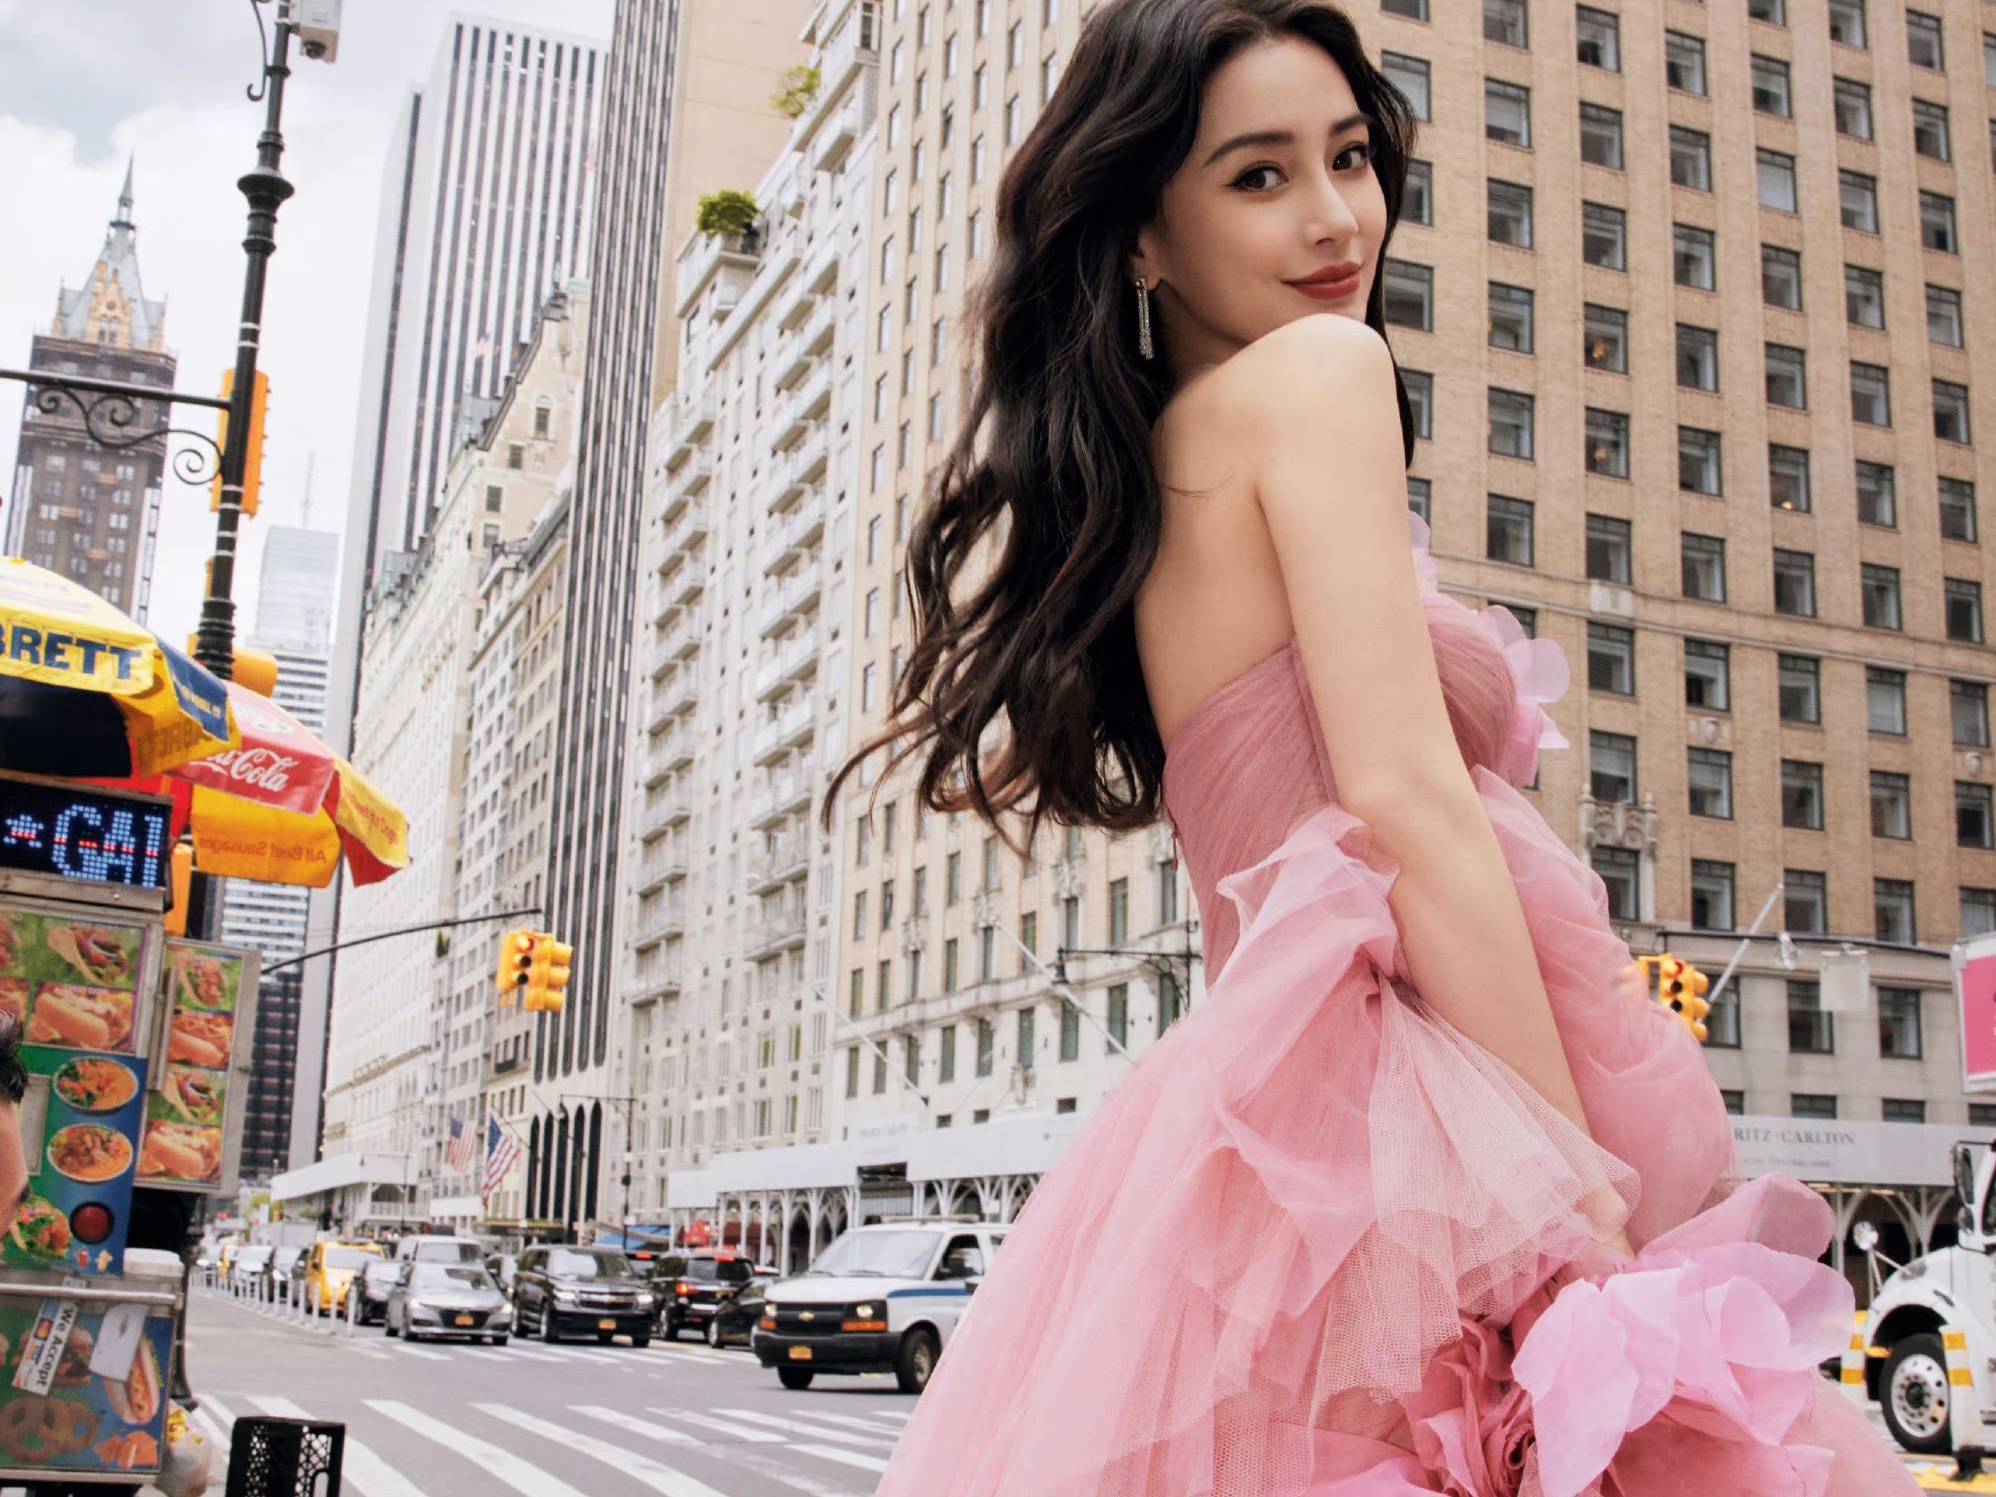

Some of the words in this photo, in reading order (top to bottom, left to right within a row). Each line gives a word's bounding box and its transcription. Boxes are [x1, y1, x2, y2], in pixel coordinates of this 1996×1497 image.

[0, 624, 142, 680] RETT
[57, 1308, 74, 1332] We
[36, 1336, 63, 1388] Accept
